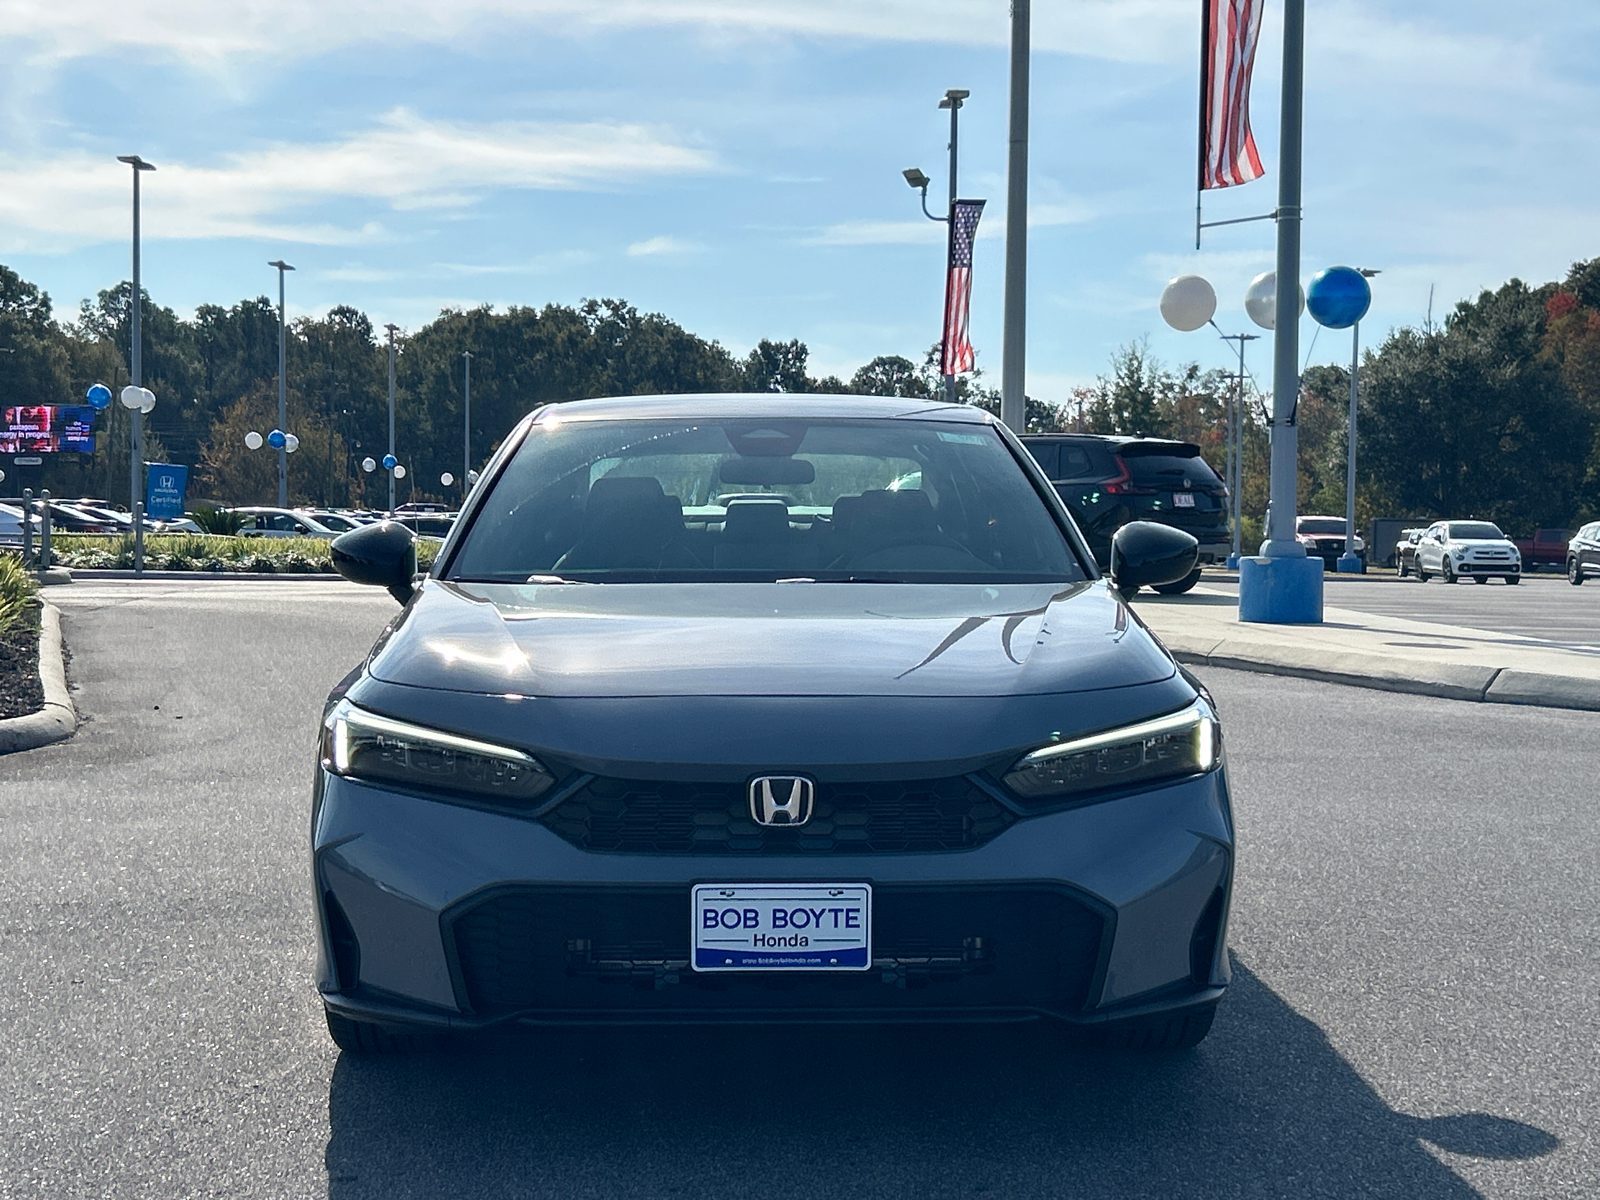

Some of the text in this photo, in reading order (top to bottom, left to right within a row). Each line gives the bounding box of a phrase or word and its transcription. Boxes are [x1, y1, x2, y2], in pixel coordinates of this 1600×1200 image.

[0, 431, 17, 439] nergy
[151, 495, 182, 503] Certified
[703, 908, 861, 929] BOB BOYTE
[753, 933, 809, 947] Honda
